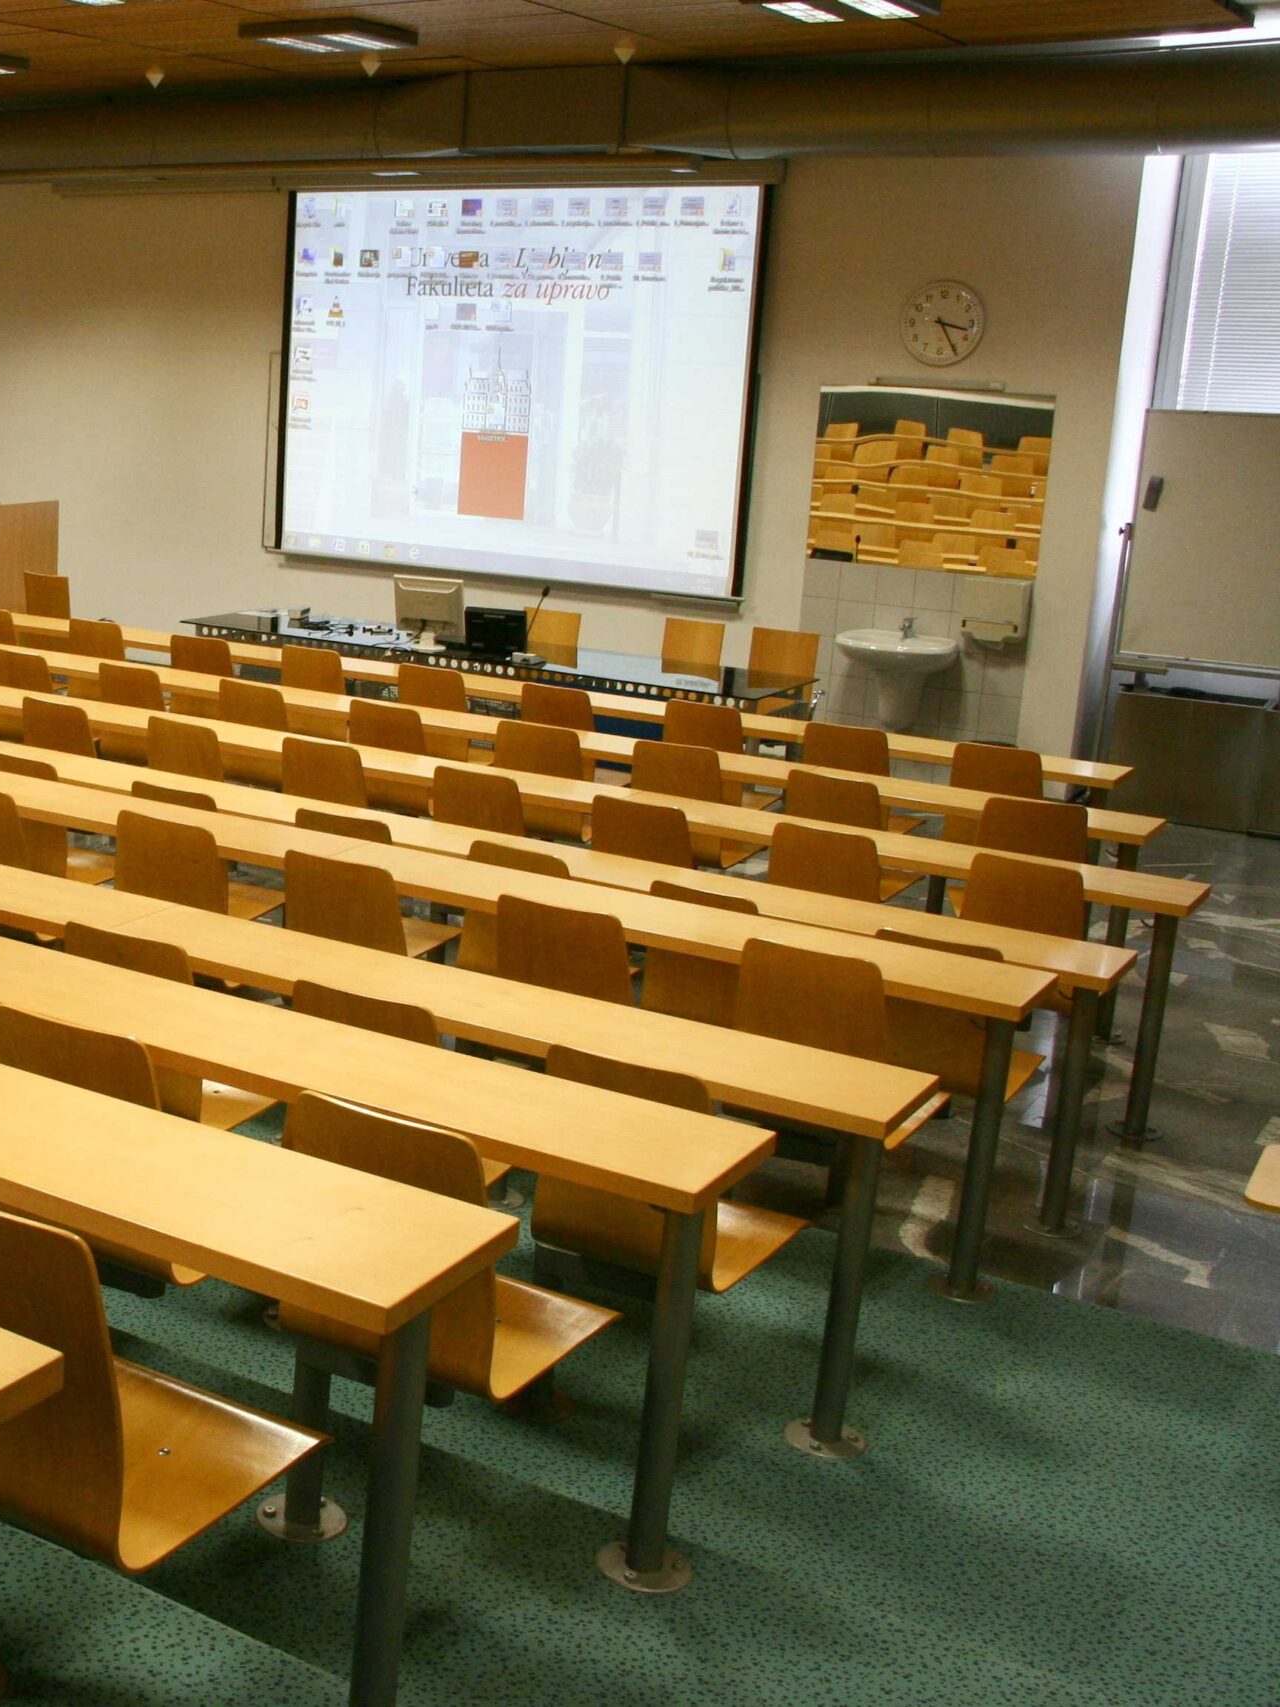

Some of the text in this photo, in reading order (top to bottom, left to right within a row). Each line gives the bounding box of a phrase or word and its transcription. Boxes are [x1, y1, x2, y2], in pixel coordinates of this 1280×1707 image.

[406, 275, 493, 298] Fakulteta
[502, 282, 528, 299] za
[536, 280, 610, 304] upravo
[926, 294, 933, 303] 11
[940, 290, 950, 299] 12
[965, 304, 971, 313] 2
[909, 318, 915, 327] 9
[968, 319, 975, 328] 3
[922, 343, 928, 352] 7
[936, 347, 943, 356] 6
